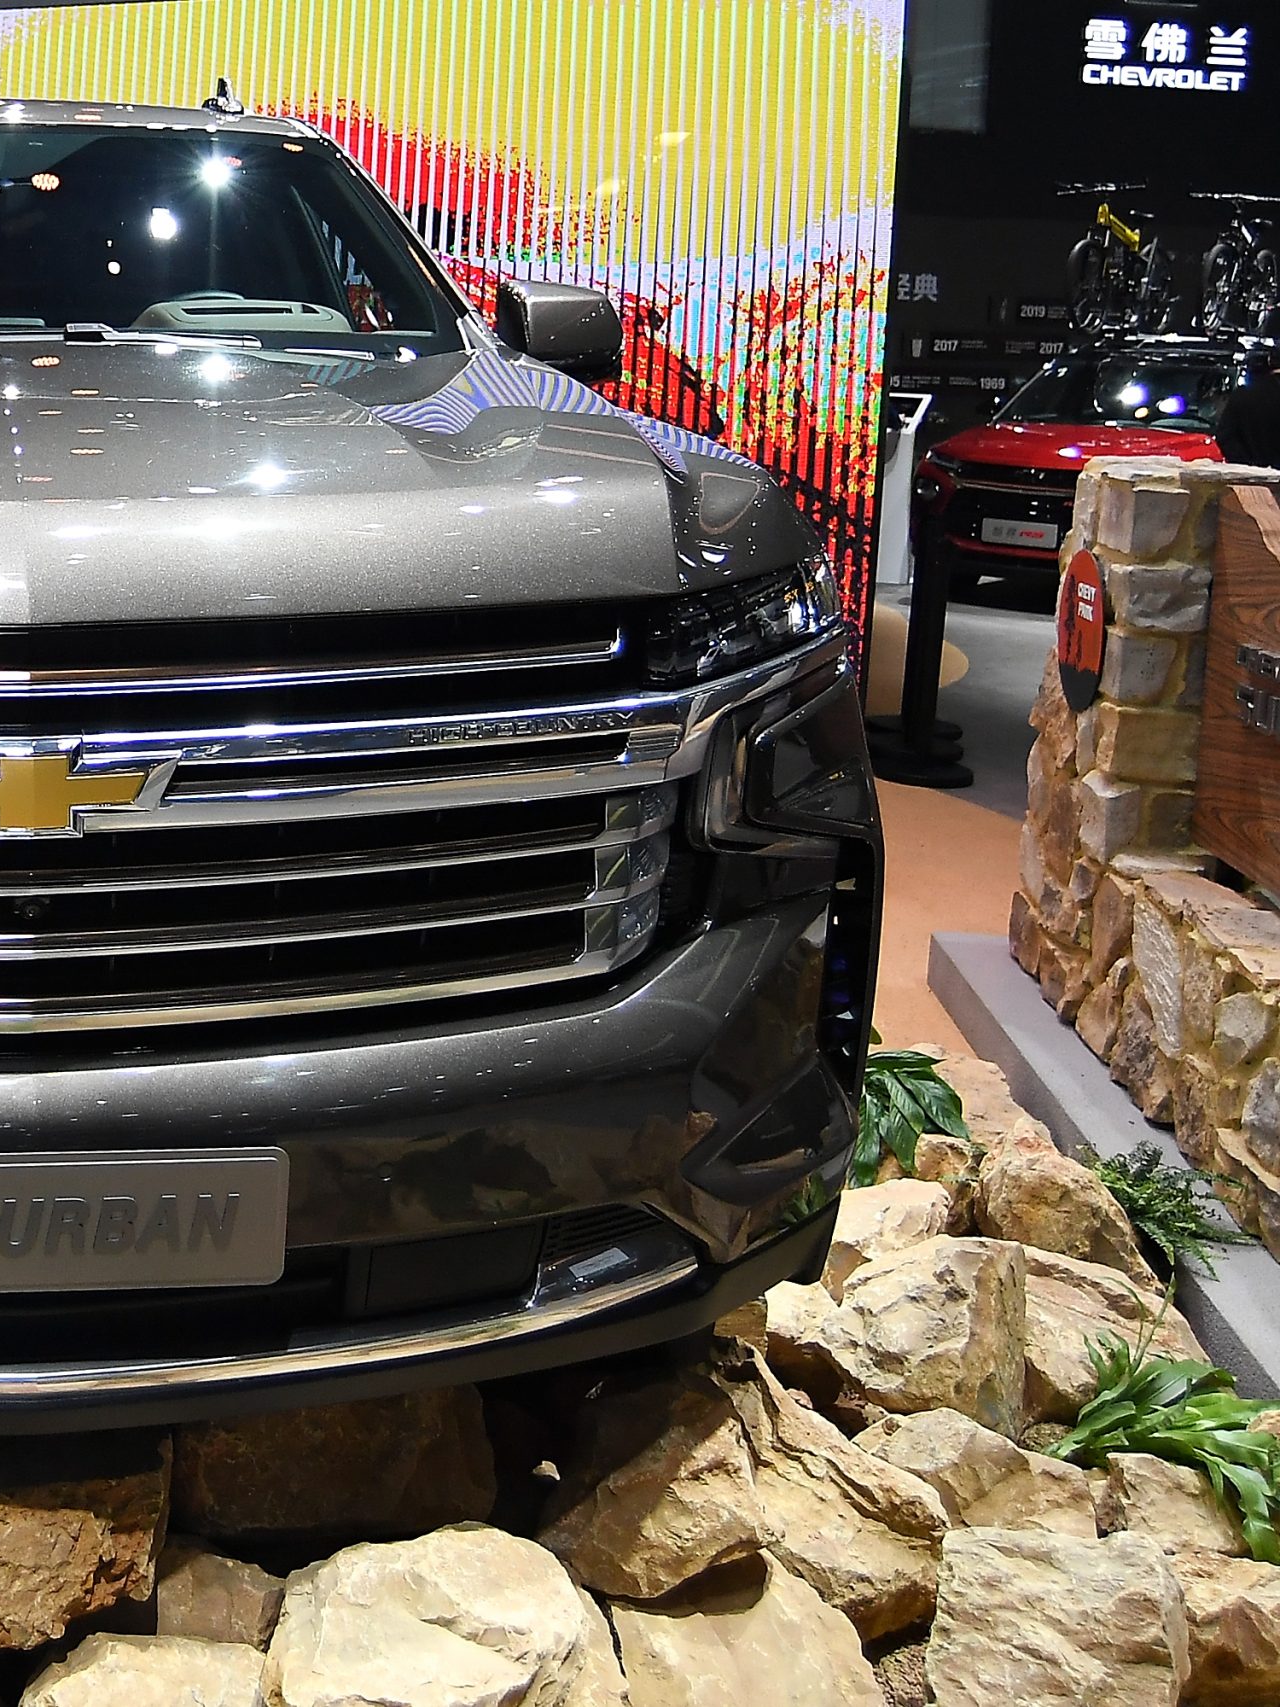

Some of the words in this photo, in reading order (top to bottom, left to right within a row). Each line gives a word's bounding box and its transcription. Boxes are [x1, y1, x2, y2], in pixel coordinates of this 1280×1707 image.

[1084, 19, 1247, 66] 雪佛兰
[1082, 63, 1246, 91] CHEVROLET
[1020, 305, 1046, 318] 2019
[933, 339, 959, 352] 2017
[1039, 341, 1064, 355] 2017
[980, 377, 1006, 390] 1969
